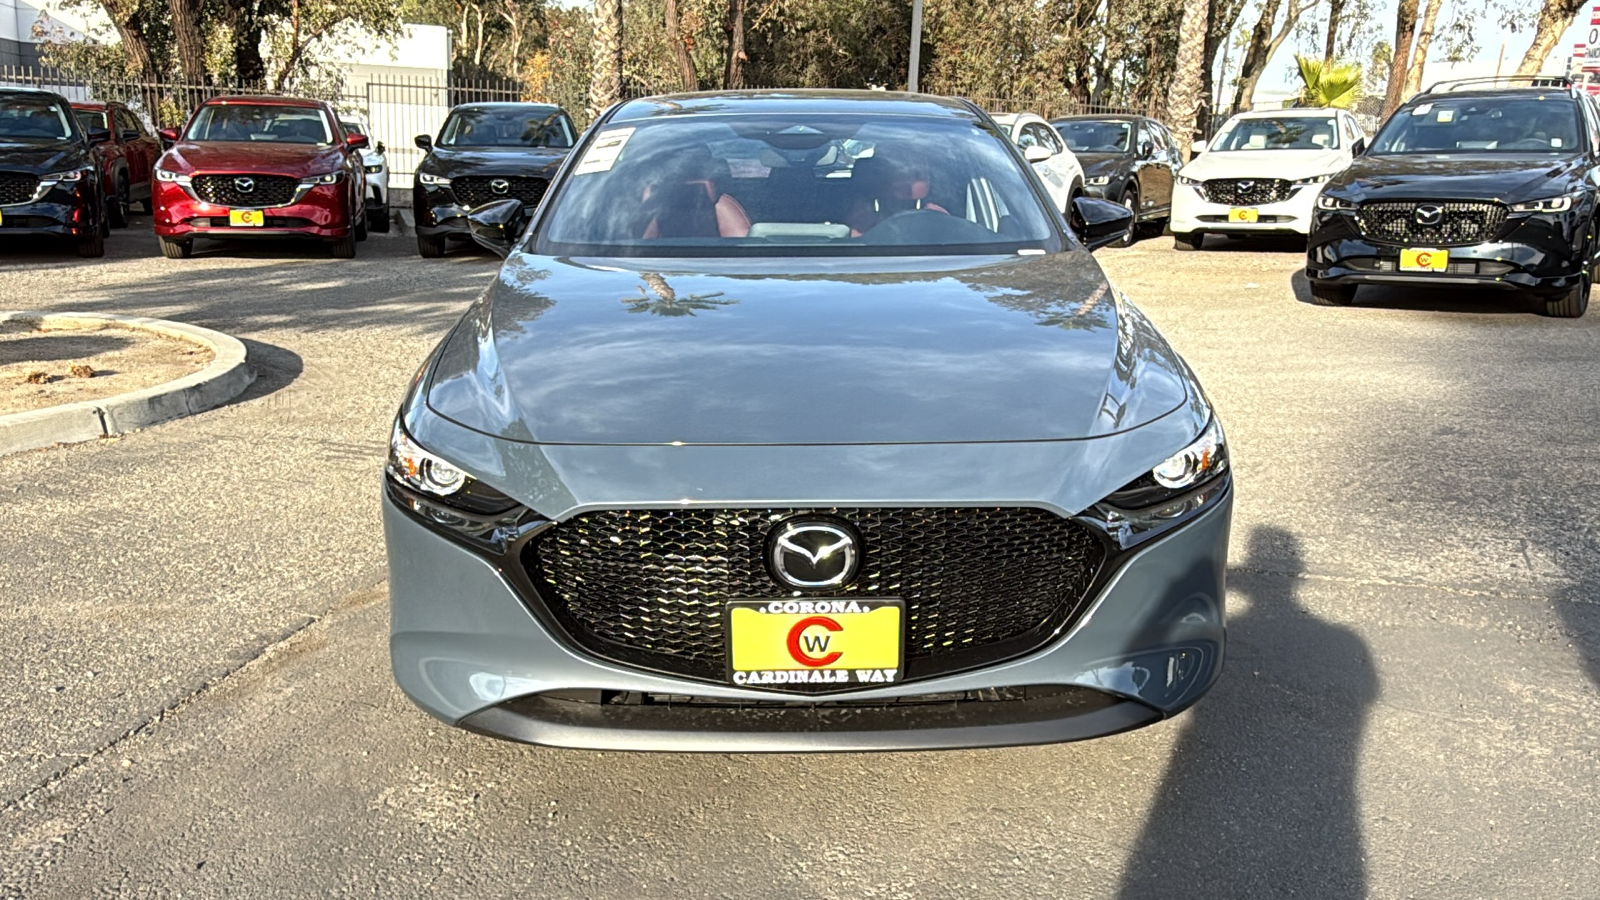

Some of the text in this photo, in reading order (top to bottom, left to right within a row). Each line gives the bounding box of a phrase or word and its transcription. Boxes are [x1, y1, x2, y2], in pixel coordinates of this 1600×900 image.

[768, 601, 862, 614] CORONA
[733, 669, 898, 684] CARDINALE WAY
